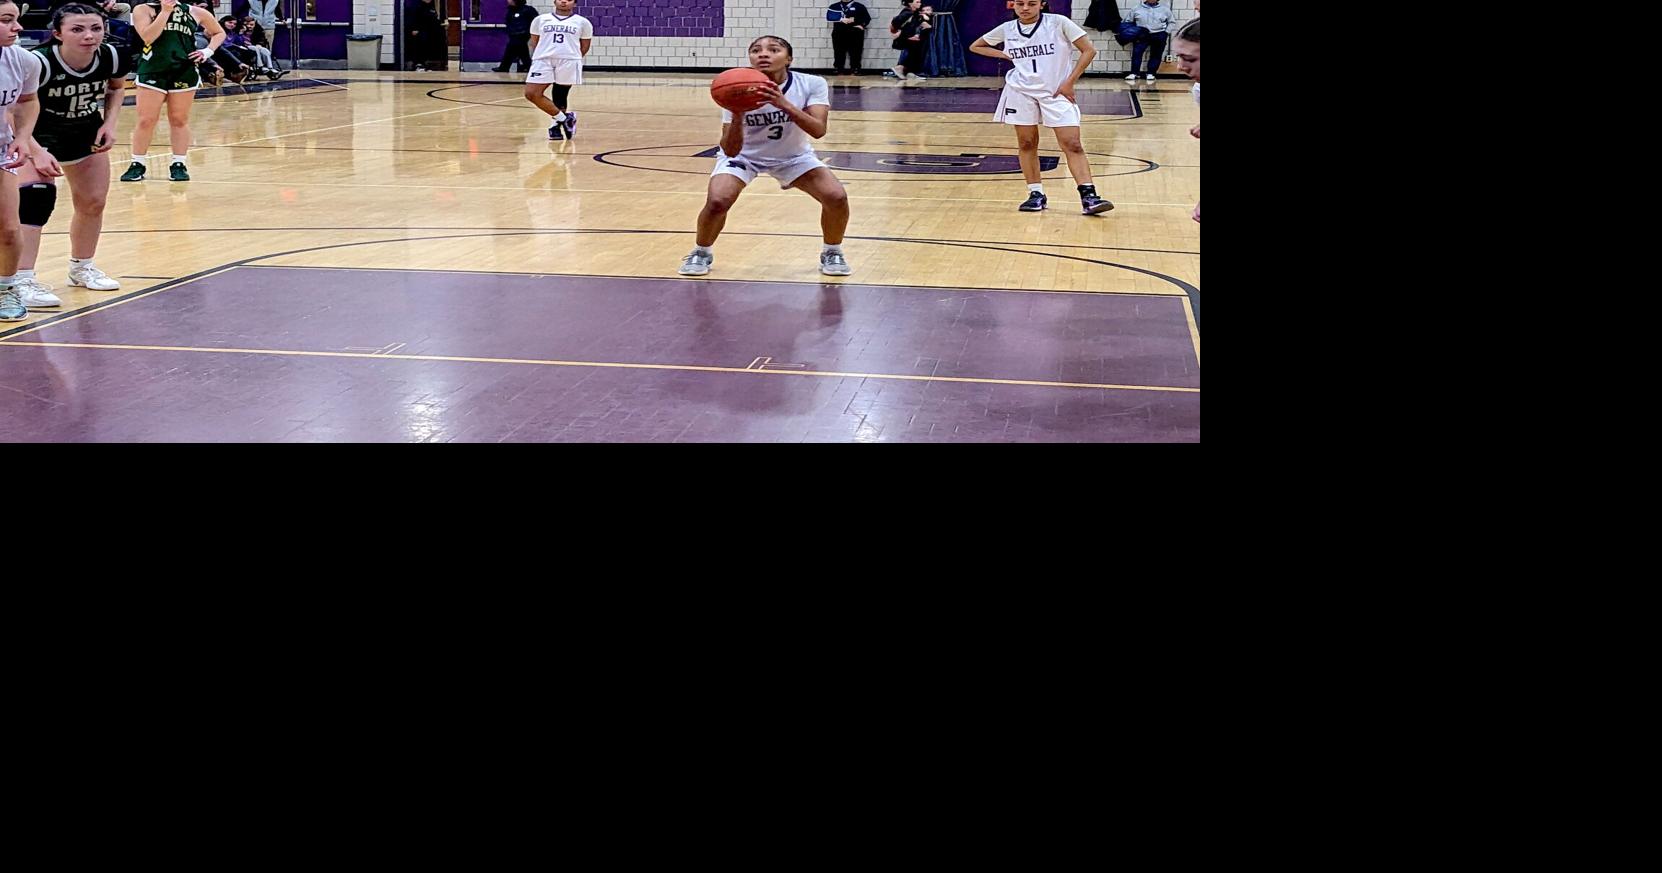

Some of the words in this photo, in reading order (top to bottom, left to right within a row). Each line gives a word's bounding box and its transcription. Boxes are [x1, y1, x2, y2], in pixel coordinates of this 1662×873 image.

[543, 24, 577, 35] GENERALS
[552, 33, 564, 44] 13
[1008, 43, 1055, 60] GENERALS
[1031, 59, 1037, 73] 1
[69, 93, 94, 112] 15
[767, 125, 784, 140] 3
